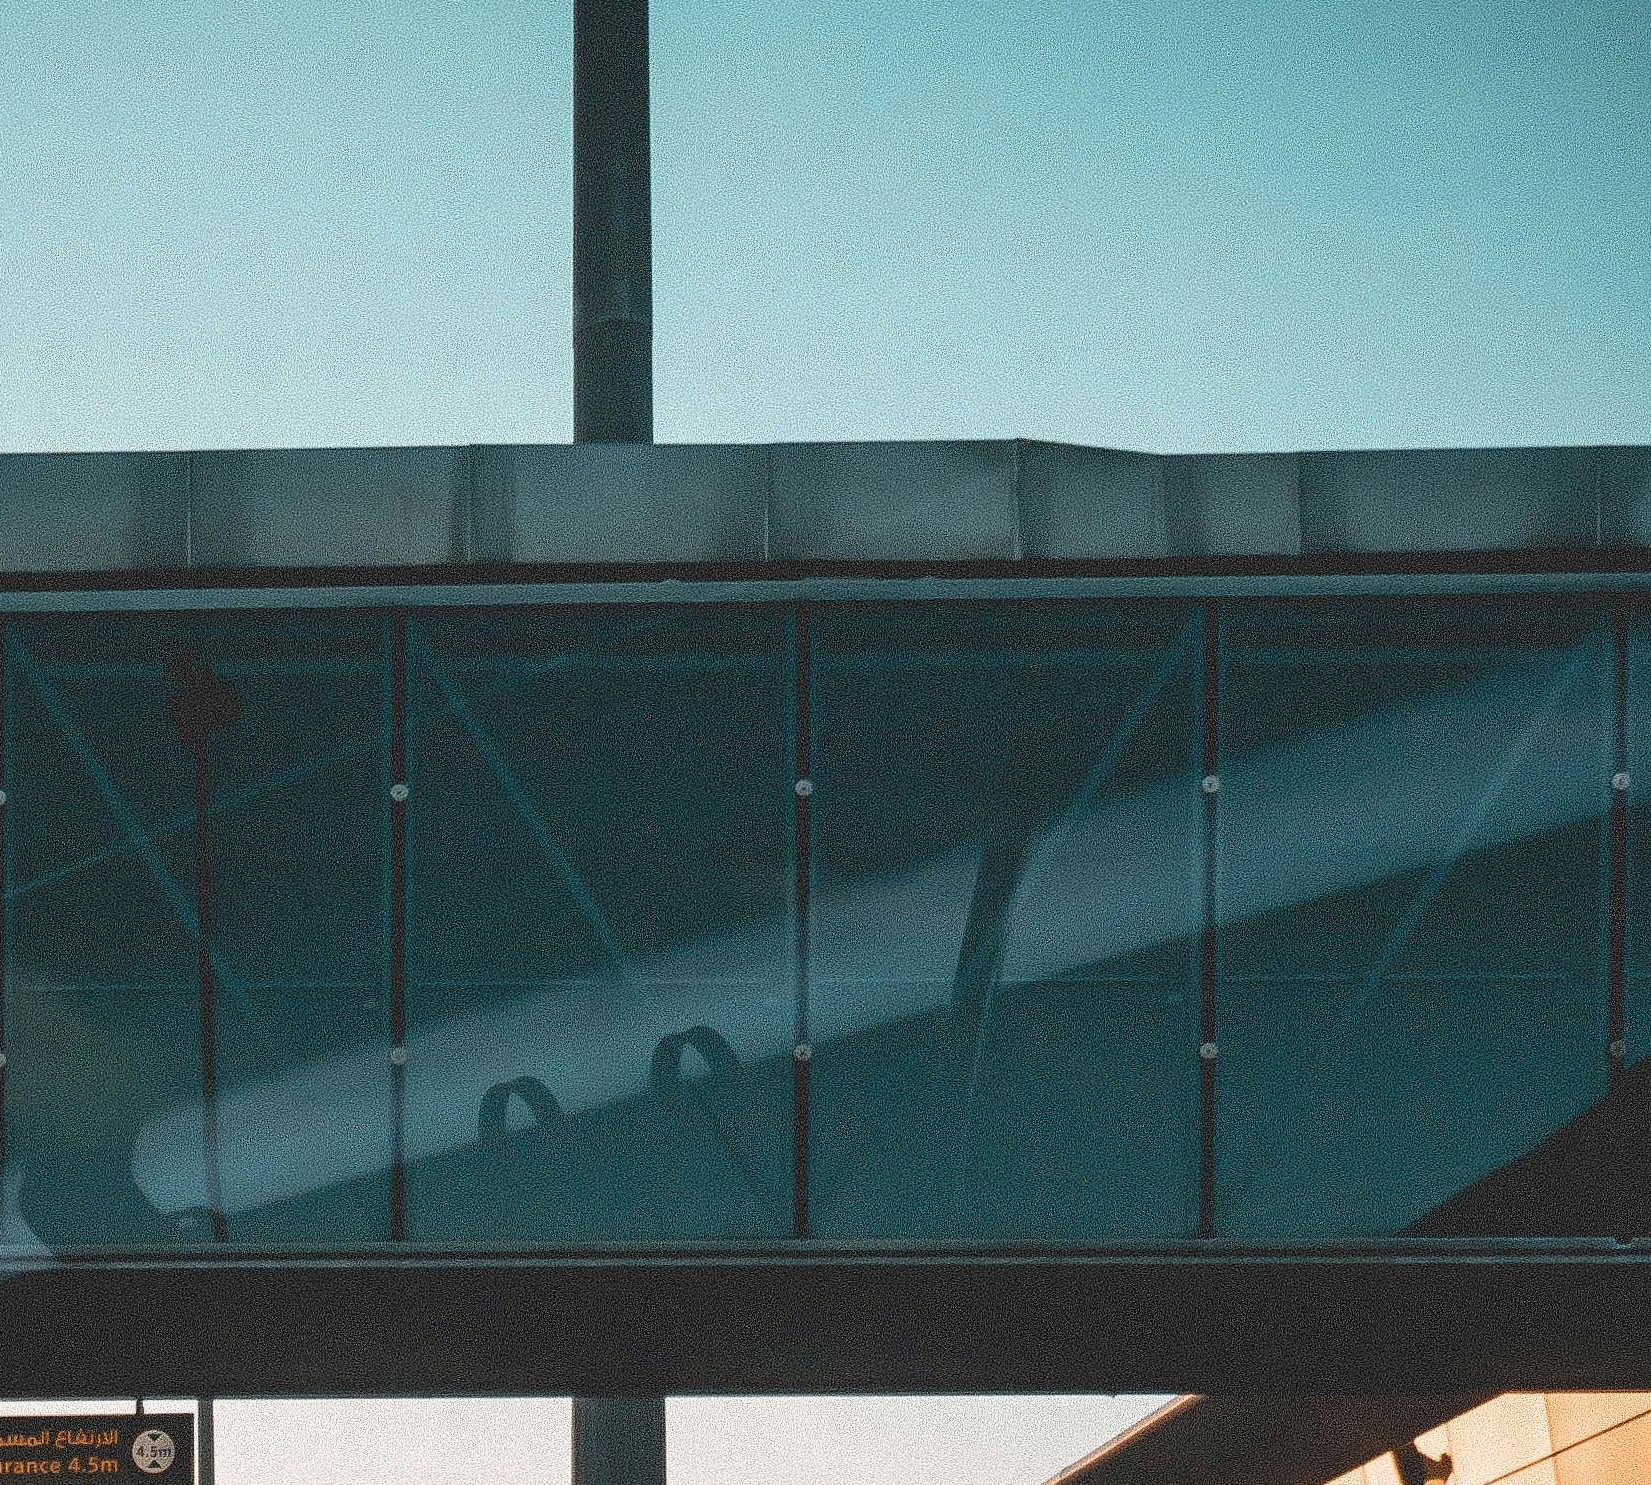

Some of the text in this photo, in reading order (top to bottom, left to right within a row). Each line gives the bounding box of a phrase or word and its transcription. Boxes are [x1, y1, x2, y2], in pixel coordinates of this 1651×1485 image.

[55, 1428, 118, 1449] الارتفاع
[136, 1445, 172, 1458] 4.5m
[68, 1456, 118, 1473] 4.5m
